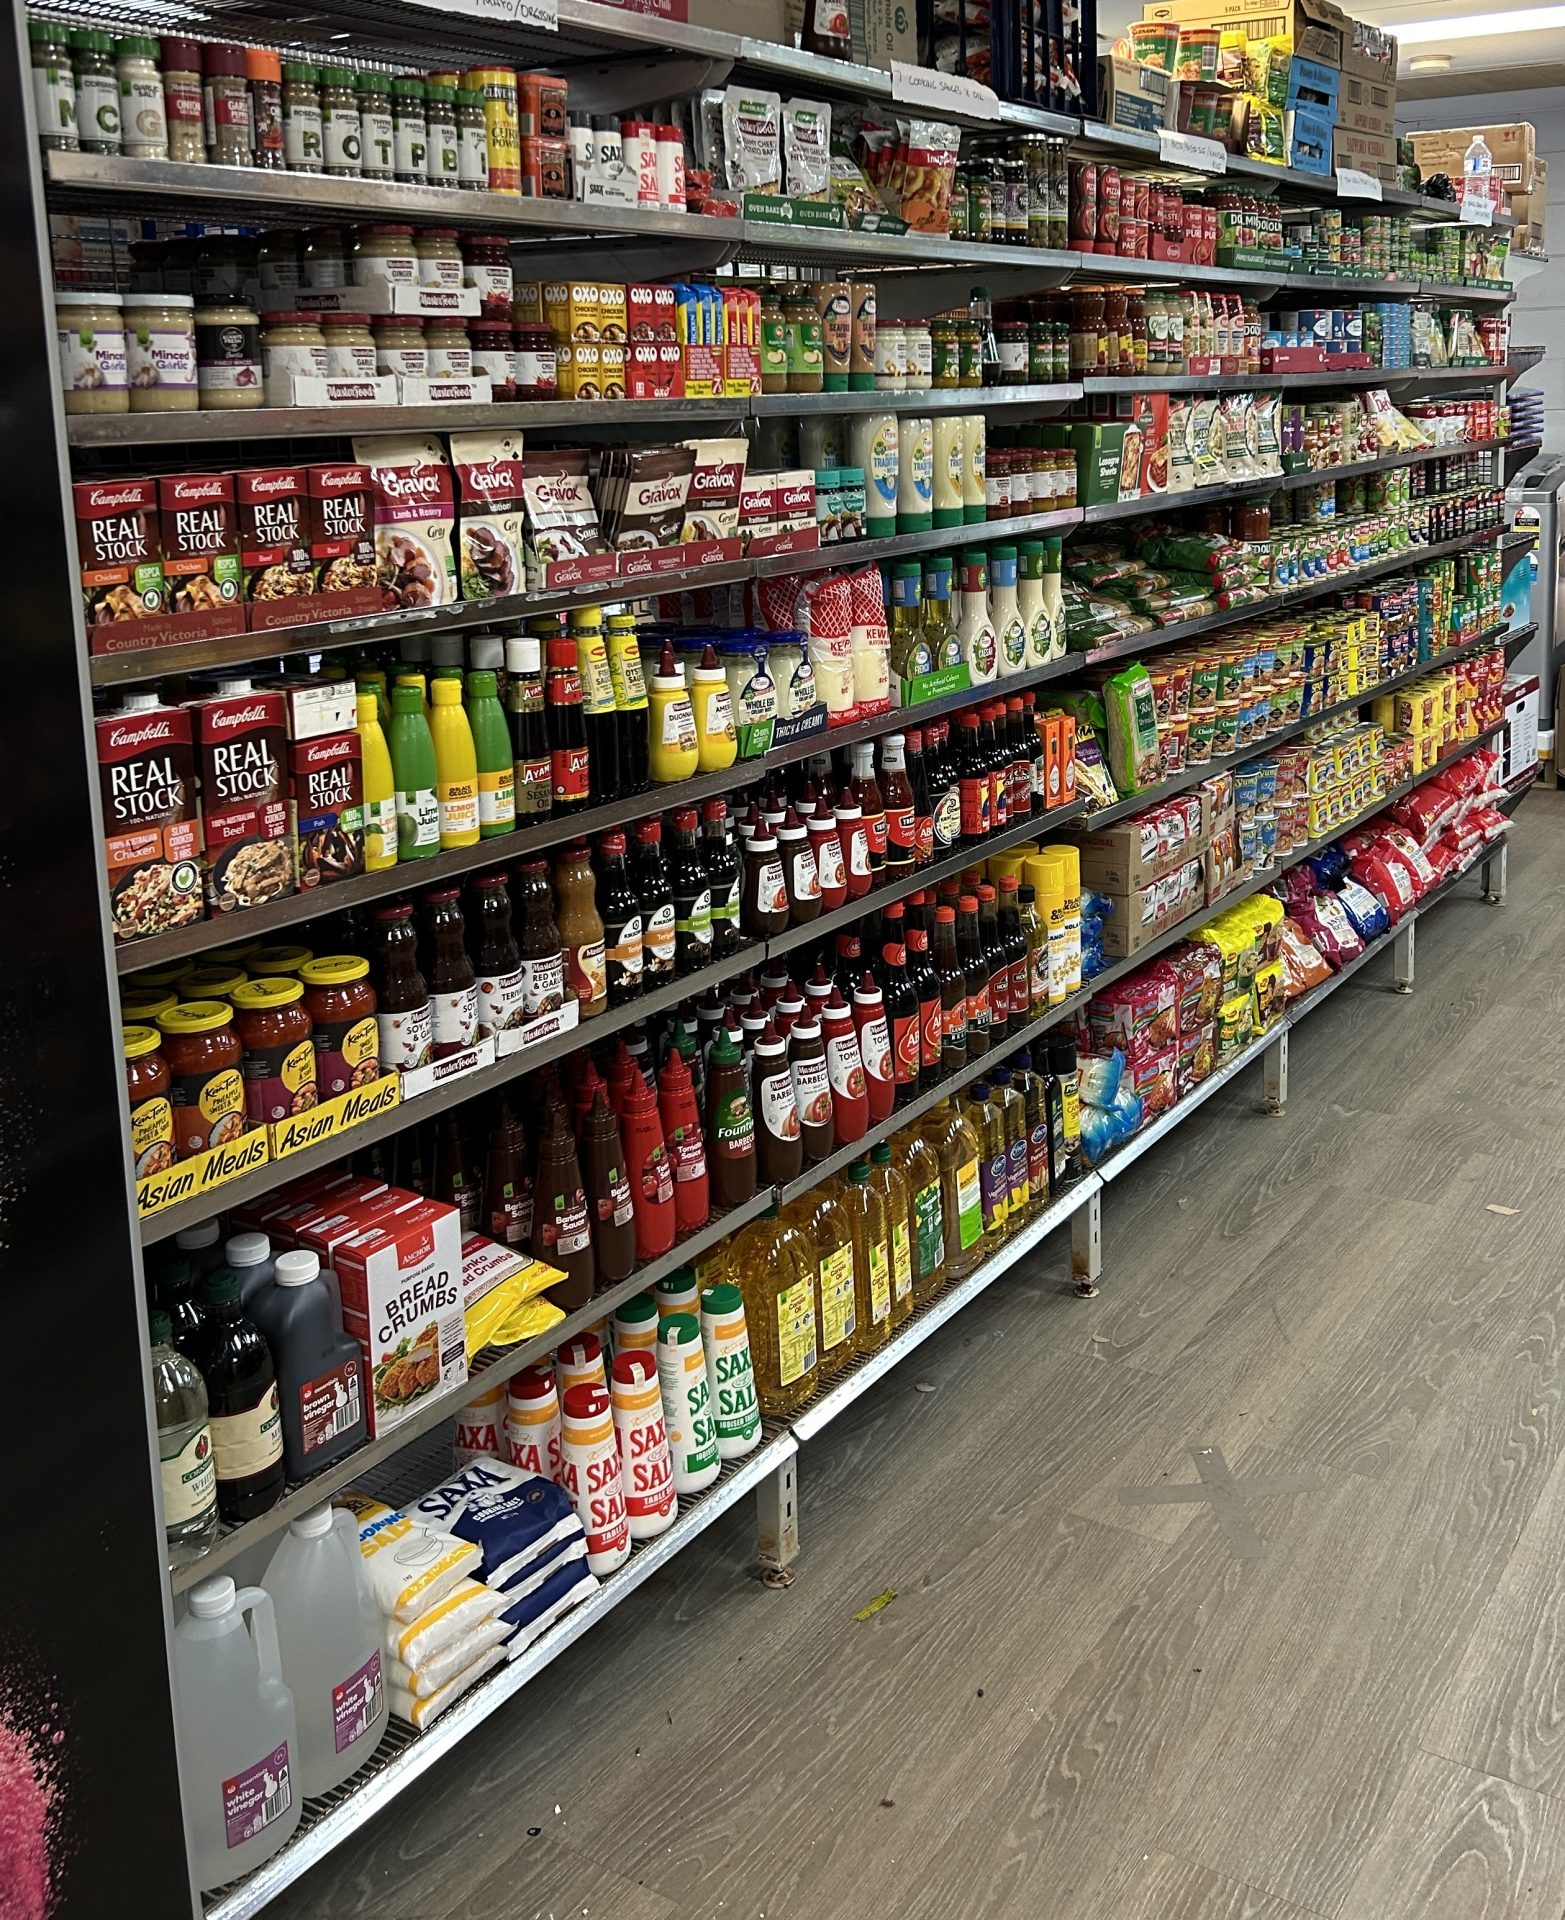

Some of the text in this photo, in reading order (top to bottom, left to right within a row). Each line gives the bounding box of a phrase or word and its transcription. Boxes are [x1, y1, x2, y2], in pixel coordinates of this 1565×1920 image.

[97, 105, 119, 133] C
[137, 109, 161, 137] G
[303, 131, 321, 158] R
[343, 135, 360, 160] O
[375, 140, 391, 165] T
[411, 143, 425, 167] P
[443, 149, 457, 172] B
[748, 204, 780, 214] OVEN BAKE
[800, 209, 830, 219] OVEN BAKE
[419, 293, 460, 309] MasterFoods
[544, 286, 568, 302] OXO
[573, 286, 599, 303] OXO
[600, 288, 624, 305] OXO
[631, 287, 653, 304] OXO
[654, 288, 674, 305] OXO
[574, 306, 598, 314] CHICKEN
[602, 307, 624, 315] CHICKEN
[151, 349, 189, 361] Minced
[576, 346, 599, 364] OXO
[601, 348, 624, 365] OXO
[635, 345, 658, 362] OXO
[660, 345, 680, 362] OXO
[156, 359, 188, 371] Garlic
[578, 366, 599, 374] CHICKEN
[328, 384, 375, 400] MasterFoods
[430, 385, 472, 401] MasterFoods
[654, 387, 670, 397] OXO
[1098, 457, 1119, 467] Lasagne
[321, 470, 364, 487] Campbell's
[693, 471, 735, 490] Gravox
[1100, 467, 1117, 477] Sheets
[175, 482, 224, 500] Campbell's
[251, 475, 298, 493] Campbell's
[91, 488, 144, 507] Campbell's
[535, 484, 582, 502] Gravox
[639, 485, 682, 505] Gravox
[783, 490, 812, 507] Gravox
[322, 497, 364, 520] REAL
[743, 494, 773, 511] Gravox
[176, 510, 224, 533] REAL
[254, 502, 298, 526] REAL
[393, 508, 411, 518] Lamb
[91, 517, 145, 543] REAL
[256, 524, 300, 543] STOCK
[324, 517, 365, 535] STOCK
[178, 531, 226, 551] STOCK
[95, 541, 148, 561] STOCK
[258, 553, 273, 562] Beef
[326, 546, 340, 554] Beef
[176, 562, 202, 571] Chicken
[95, 571, 122, 582] Chicken
[265, 605, 352, 626] Country Victoria
[106, 628, 207, 651] Country Victoria
[746, 700, 766, 710] WHOLE
[212, 705, 269, 729] Campbell's
[110, 722, 174, 747] Campbell's
[776, 724, 795, 739] THICK
[801, 714, 824, 731] CREAMY
[214, 739, 275, 775] REAL
[307, 741, 352, 761] Campbell's
[111, 757, 180, 796] REAL
[216, 767, 278, 797] STOCK
[307, 767, 351, 794] REAL
[114, 787, 184, 819] STOCK
[310, 786, 352, 809] STOCK
[146, 811, 172, 821] NATURAL
[266, 803, 284, 814] SLOW
[419, 806, 438, 818] Lime
[444, 803, 476, 813] LEMON
[445, 810, 476, 821] JUICE
[265, 811, 286, 823] COOKED
[313, 819, 325, 827] Fish
[170, 824, 190, 835] SLOW
[223, 824, 246, 837] Beef
[169, 833, 193, 846] COOKED
[114, 845, 155, 861] Chicken
[532, 972, 548, 982] RED
[523, 1016, 560, 1044] MasterFoods
[432, 1051, 479, 1082] MasterFoods
[280, 1085, 396, 1153] Asian Meals
[681, 1148, 702, 1161] Sauce
[138, 1139, 265, 1210] Asian Meals
[555, 1208, 587, 1225] Barbecue
[561, 1218, 586, 1231] Sauce
[403, 1244, 431, 1264] ANCHOR
[475, 1252, 514, 1278] Crumbs
[830, 1263, 846, 1277] Canola
[835, 1271, 843, 1281] Oil
[385, 1270, 449, 1319] BREAD
[789, 1294, 806, 1311] Canola
[378, 1286, 458, 1344] CRUMBS
[794, 1306, 802, 1314] Oil
[303, 1393, 331, 1413] brown
[303, 1399, 336, 1422] vinegar
[418, 1466, 511, 1521] SAXA
[643, 1491, 666, 1506] TABLE
[473, 1496, 521, 1521] COOKING SALT
[361, 1518, 414, 1559] SALT
[602, 1525, 624, 1542] TABLE
[335, 1693, 359, 1714] white
[336, 1696, 365, 1722] vinegar
[226, 1786, 255, 1808] white
[226, 1788, 265, 1817] vinegar
